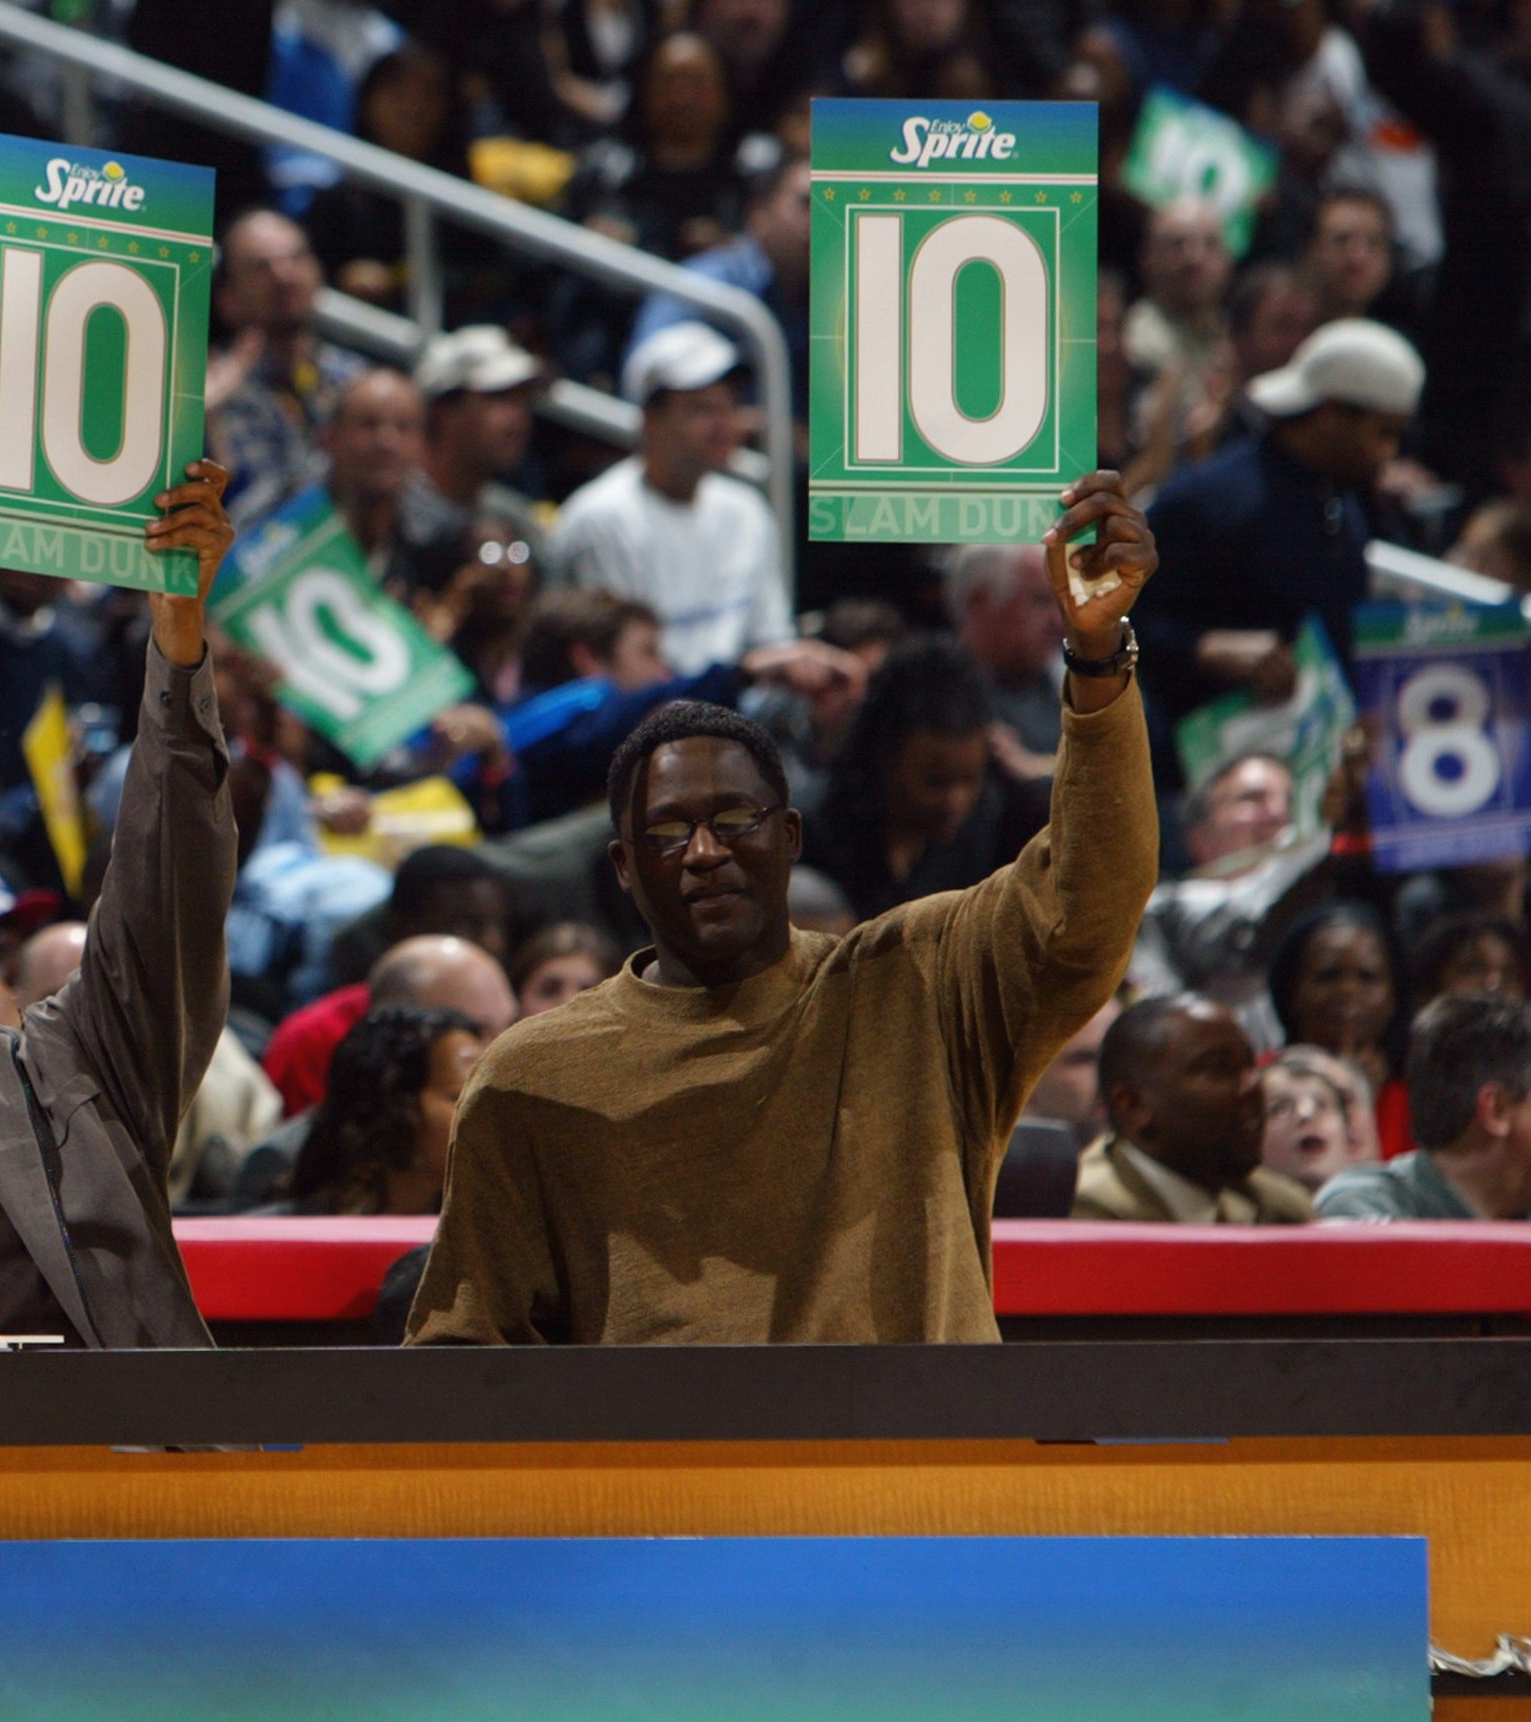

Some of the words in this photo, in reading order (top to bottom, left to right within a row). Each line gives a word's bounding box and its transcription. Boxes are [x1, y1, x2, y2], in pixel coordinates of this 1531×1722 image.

[889, 111, 1016, 168] Sprite
[930, 118, 966, 136] Enjoy
[34, 158, 145, 209] Sprite
[855, 213, 1050, 466] 10
[809, 496, 941, 535] SLAM
[958, 496, 1056, 537] DUN
[79, 532, 198, 589] DUNK
[248, 566, 412, 721] 10
[1399, 664, 1501, 817] 8
